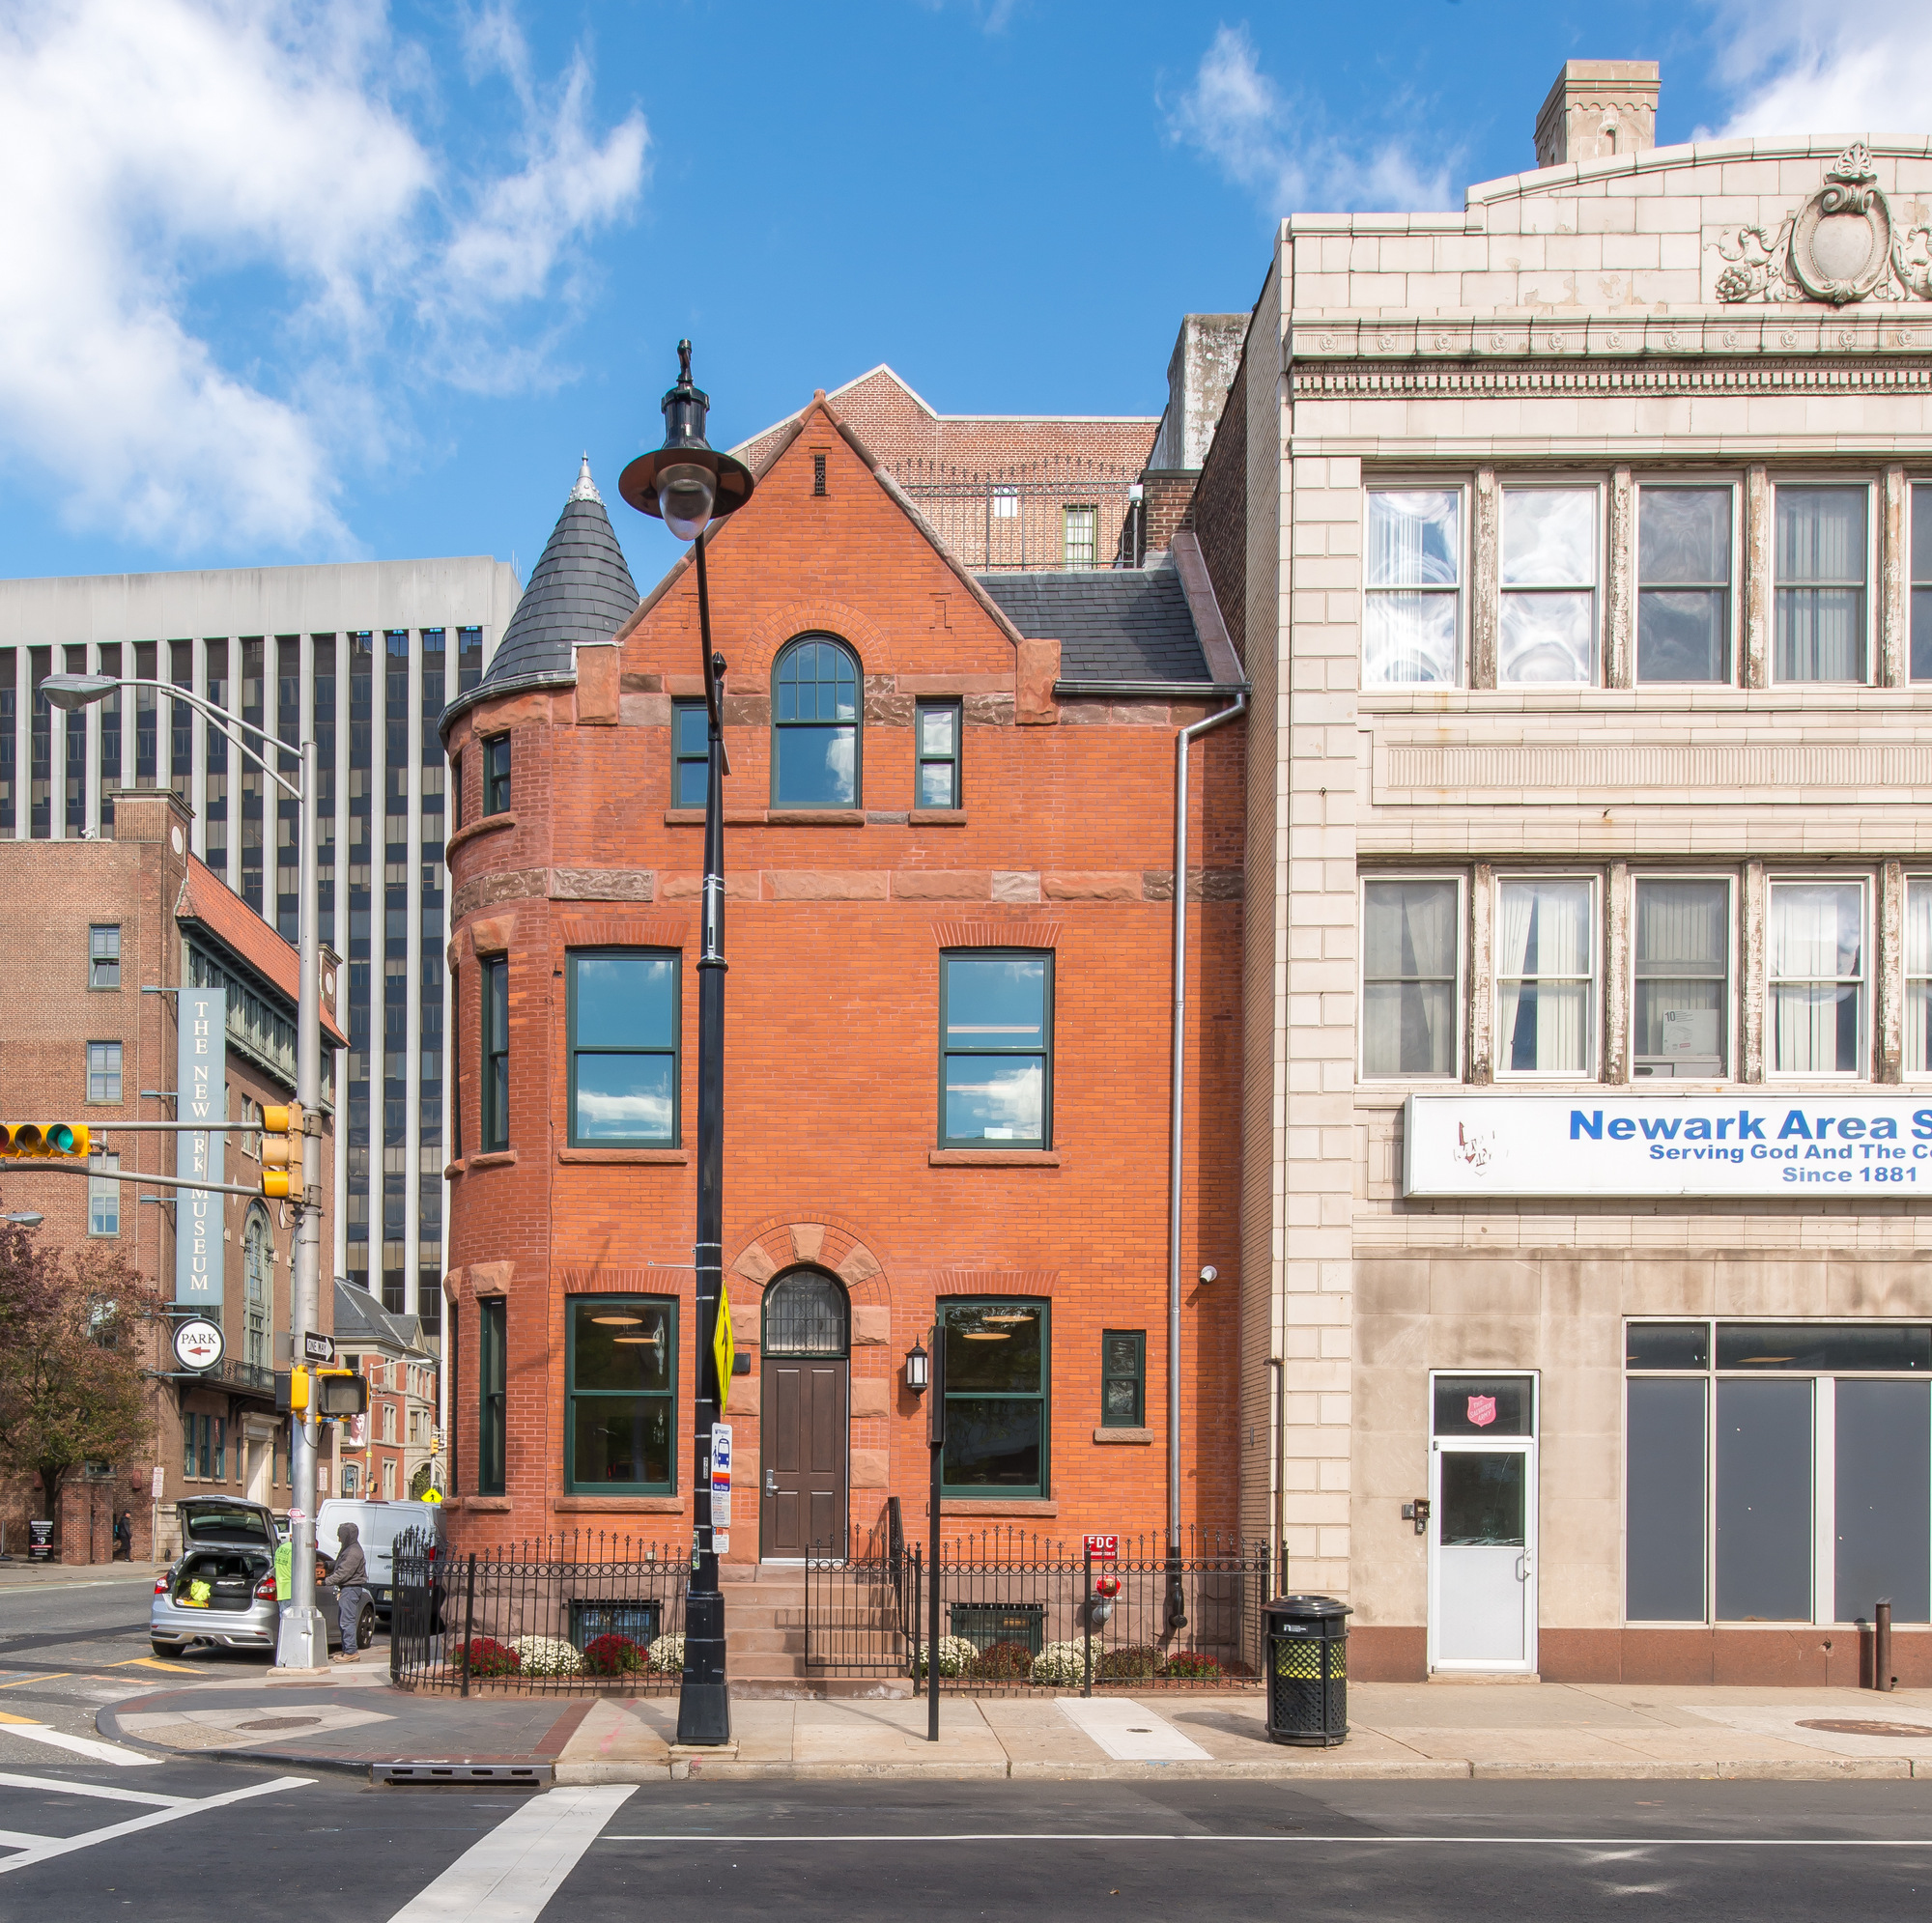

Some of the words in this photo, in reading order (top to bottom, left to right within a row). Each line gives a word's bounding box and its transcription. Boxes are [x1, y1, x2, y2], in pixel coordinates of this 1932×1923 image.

[1664, 1011, 1676, 1022] 10
[194, 1002, 209, 1055] THE
[1570, 1110, 1767, 1140] Newark
[1776, 1110, 1898, 1140] Area
[1649, 1144, 1744, 1163] Serving
[1750, 1144, 1798, 1159] God
[1804, 1144, 1853, 1159] And
[1860, 1144, 1906, 1159] The
[1913, 1144, 1932, 1159] C
[1782, 1167, 1852, 1182] Since
[1860, 1167, 1916, 1182] 1881
[190, 1189, 209, 1290] MUSEUM
[181, 1334, 216, 1344] PARK
[308, 1340, 317, 1352] ONE
[318, 1342, 327, 1354] WAY
[1478, 1408, 1492, 1422] ARMY
[1088, 1537, 1114, 1548] FDC
